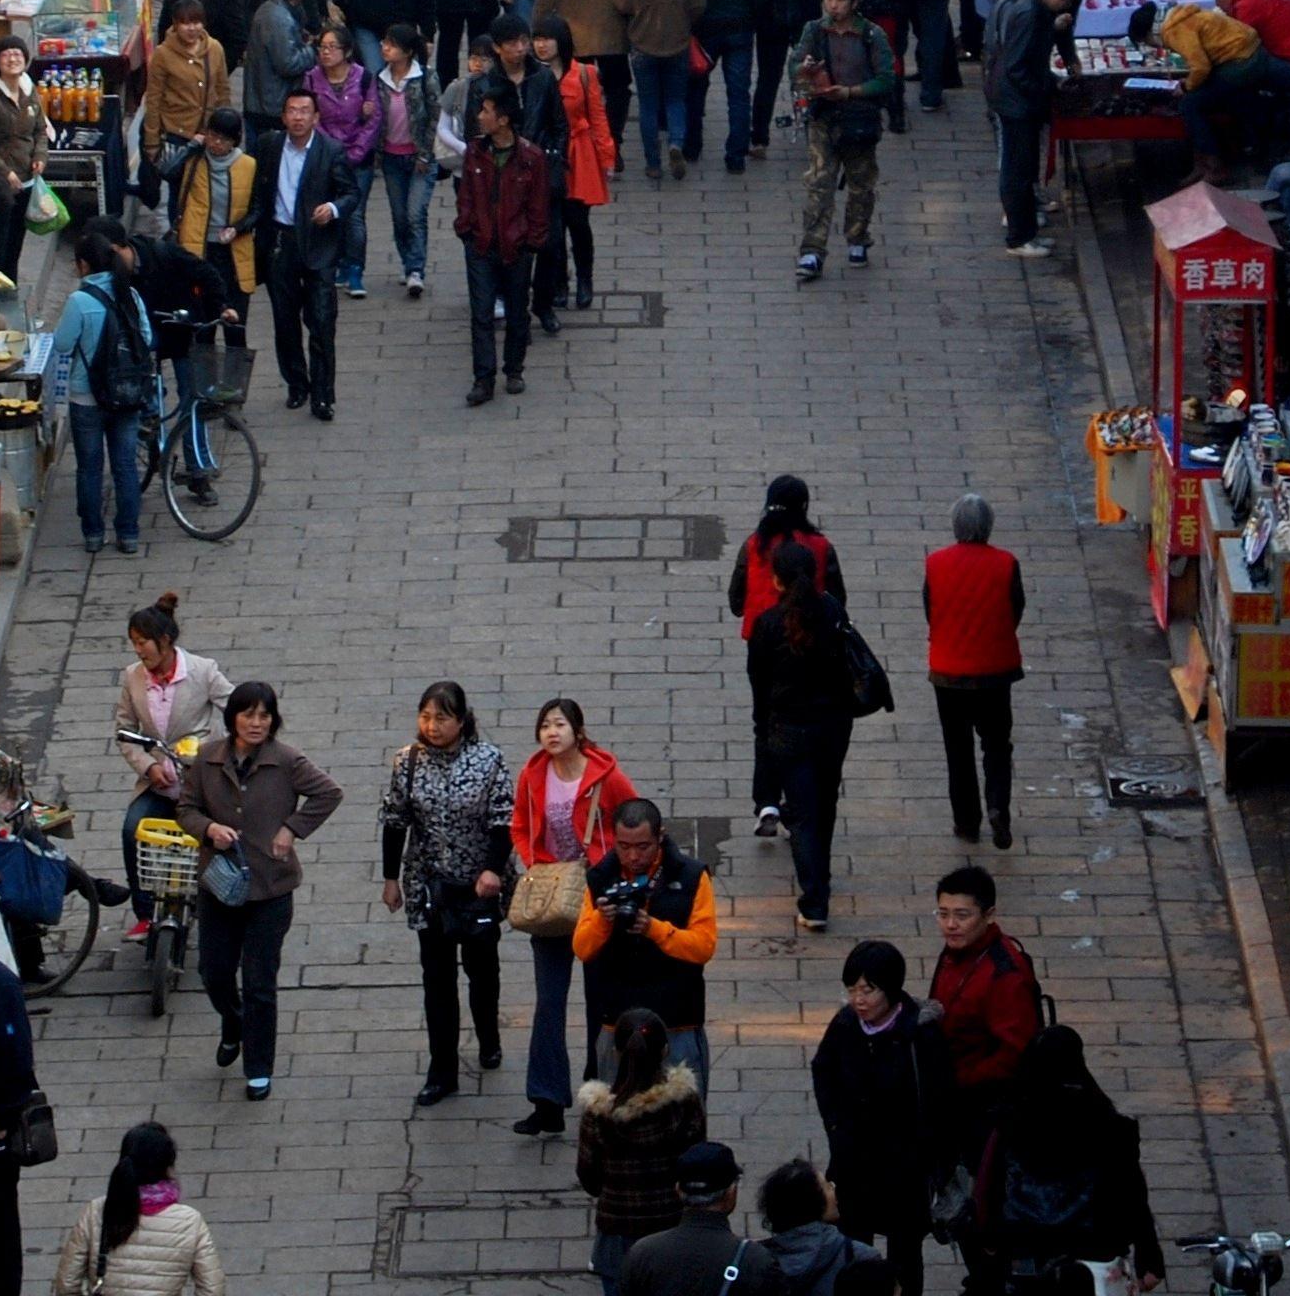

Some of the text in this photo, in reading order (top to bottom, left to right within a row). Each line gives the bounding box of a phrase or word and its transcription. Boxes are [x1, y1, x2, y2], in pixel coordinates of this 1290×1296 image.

[1182, 258, 1265, 291] 香草肉
[1177, 478, 1199, 546] 平香
